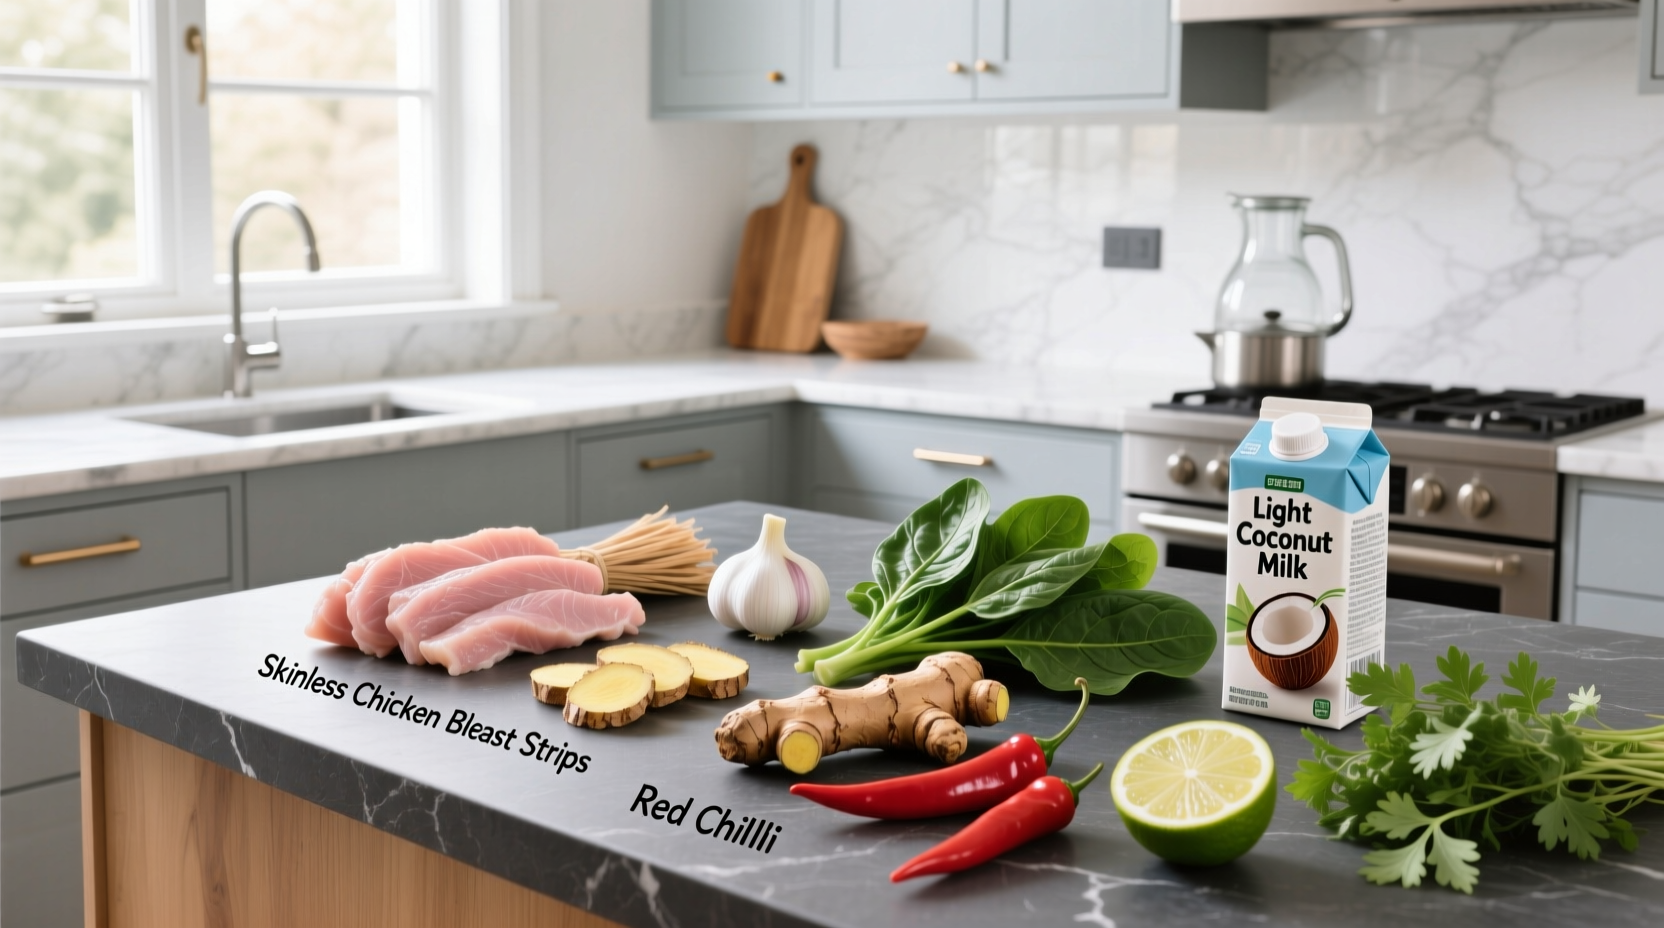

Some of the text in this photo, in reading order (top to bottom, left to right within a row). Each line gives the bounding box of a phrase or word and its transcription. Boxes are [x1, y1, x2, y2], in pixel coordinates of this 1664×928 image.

[1253, 496, 1312, 528] Light
[1236, 521, 1333, 554] Coconut
[1257, 551, 1308, 580] Milk
